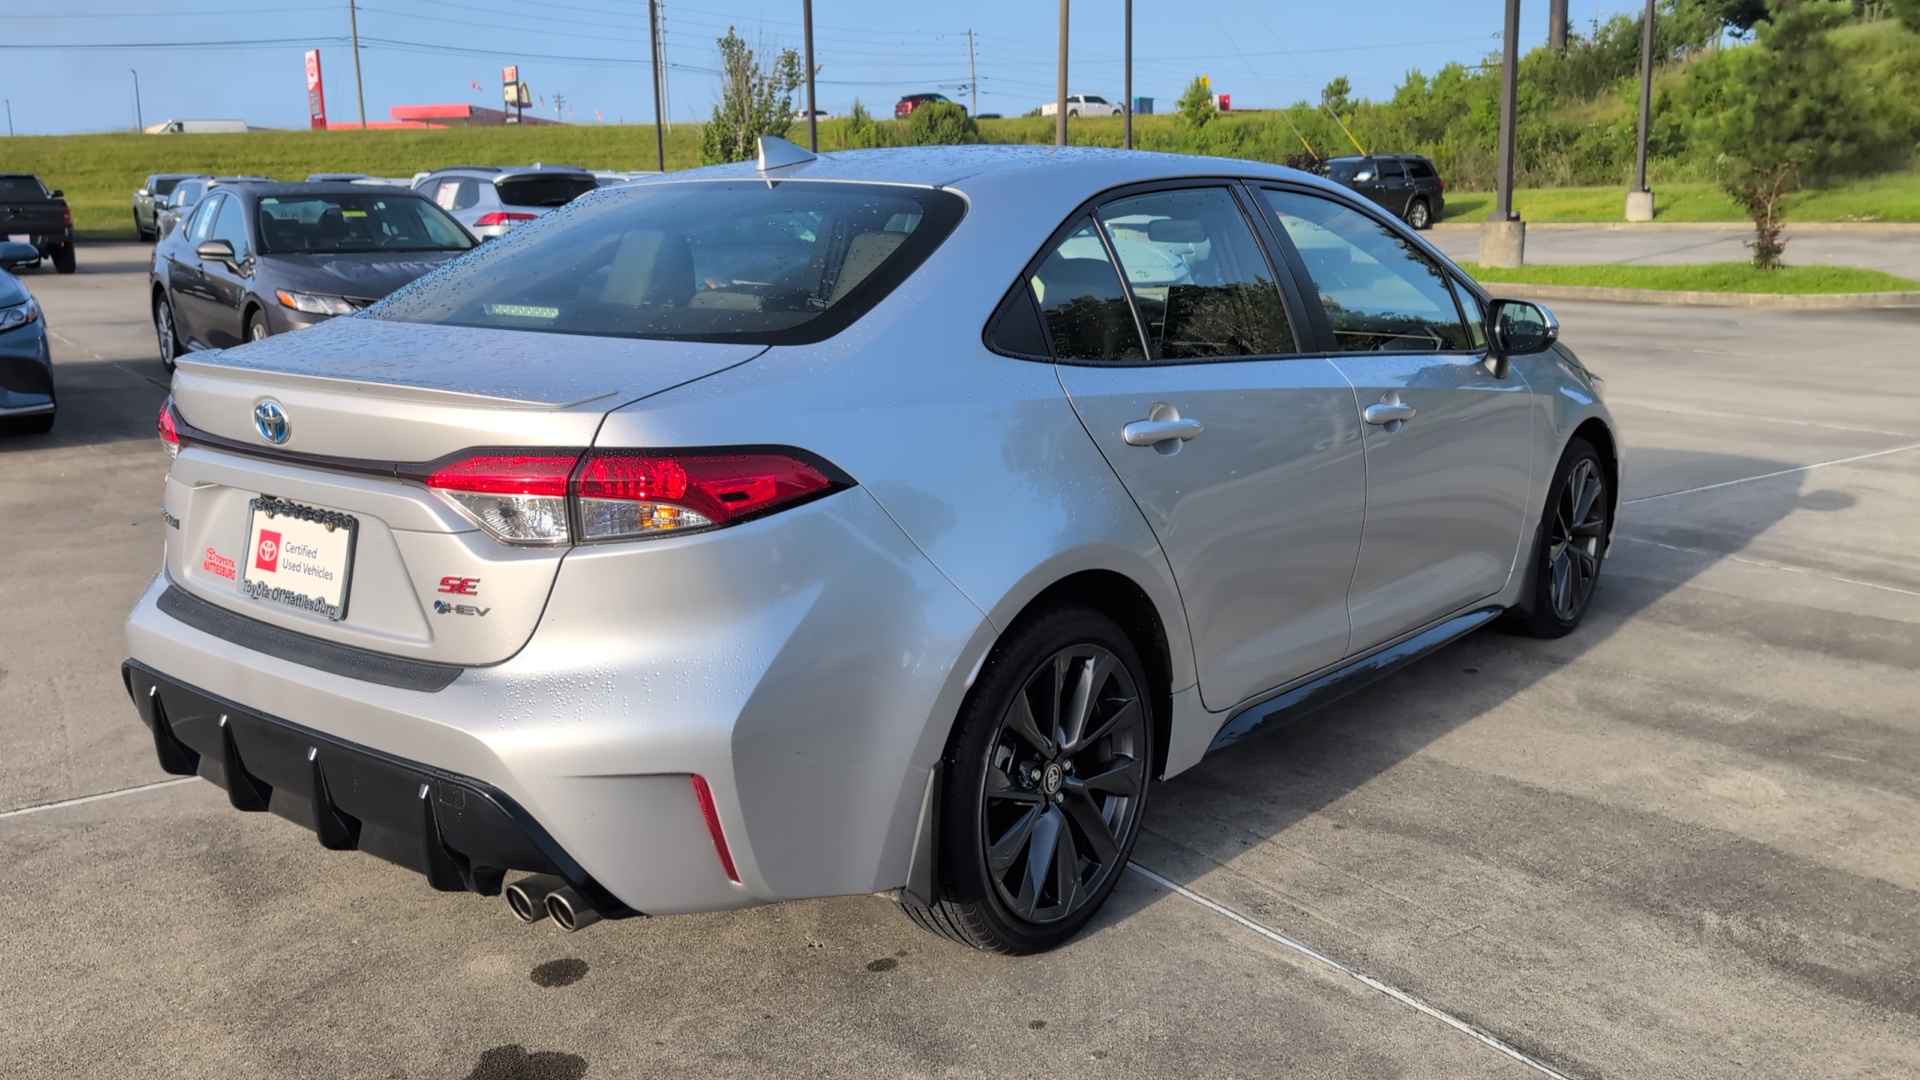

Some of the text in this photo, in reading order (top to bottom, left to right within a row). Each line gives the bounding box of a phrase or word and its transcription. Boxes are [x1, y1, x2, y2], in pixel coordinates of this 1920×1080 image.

[285, 541, 318, 559] Certified
[282, 558, 334, 581] Used Vehicles
[437, 575, 481, 596] SE
[243, 580, 270, 600] Toyota
[285, 590, 339, 619] Hattiesburg
